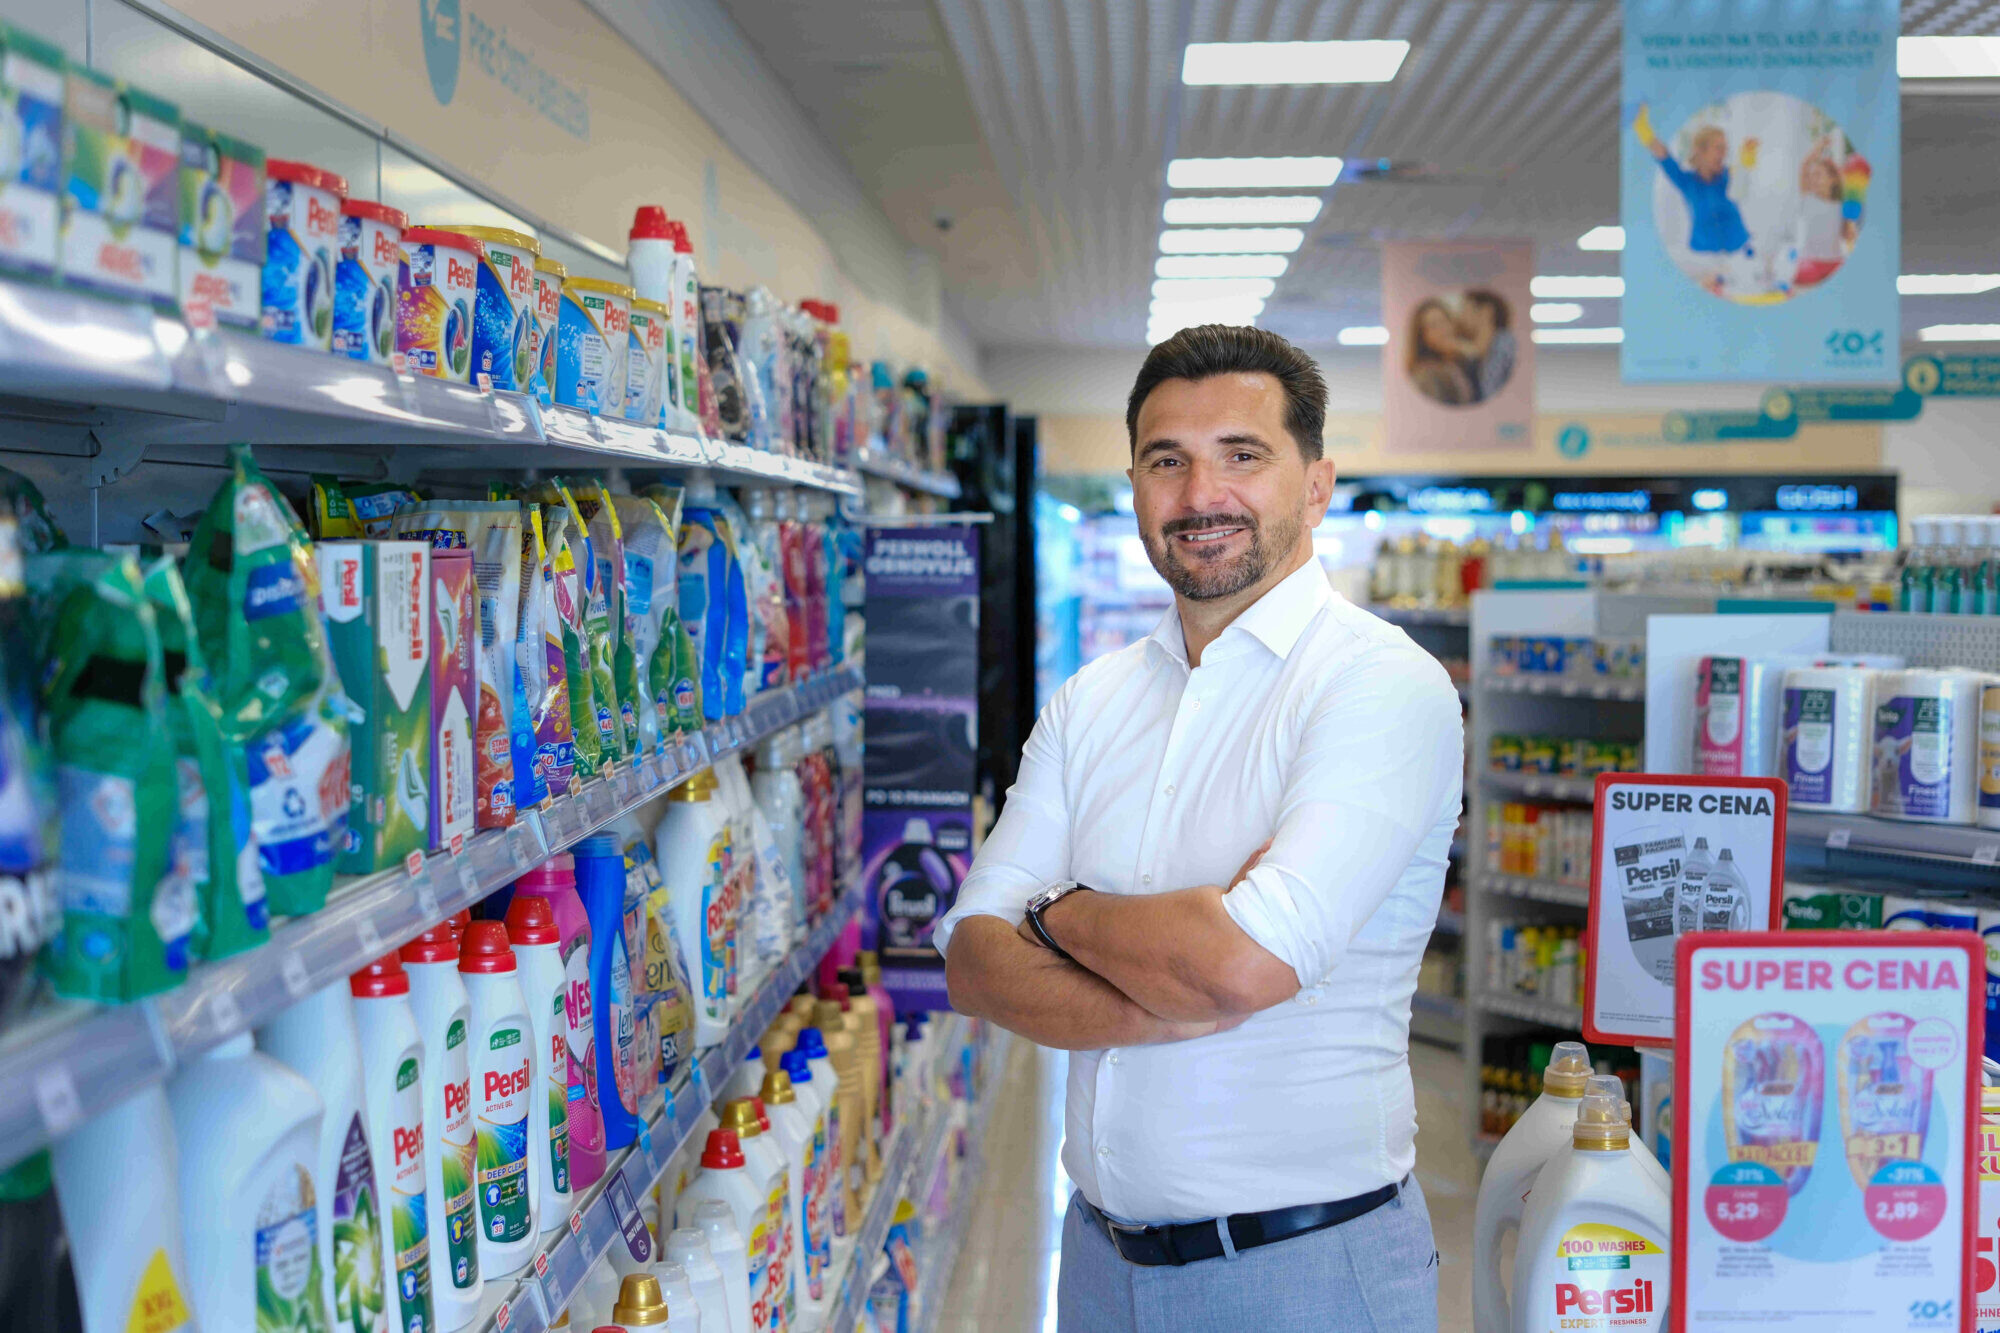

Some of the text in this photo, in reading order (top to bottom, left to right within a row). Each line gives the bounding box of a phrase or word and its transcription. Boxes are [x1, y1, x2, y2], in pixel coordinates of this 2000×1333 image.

[874, 540, 968, 557] PERWOLL
[866, 557, 976, 575] OBNOVUJE
[343, 559, 359, 606] Persil
[411, 551, 423, 660] Persil
[444, 729, 454, 824] Persil
[494, 794, 505, 804] 34
[1612, 791, 1771, 816] SUPER CENA
[1625, 858, 1680, 886] Persil
[1705, 894, 1733, 905] Persil
[1788, 901, 1823, 921] Tento
[1700, 960, 1833, 991] SUPER
[1843, 960, 1960, 991] CENA
[484, 1057, 530, 1102] Persil
[485, 1100, 514, 1113] ACTIVE GEL
[487, 1160, 525, 1180] DEEP CLEAN
[1717, 1201, 1759, 1221] 5,29
[1563, 1240, 1646, 1254] 100 WASHES
[1555, 1278, 1653, 1315] Persil
[1560, 1318, 1647, 1329] EXPERT FRESHNESS
